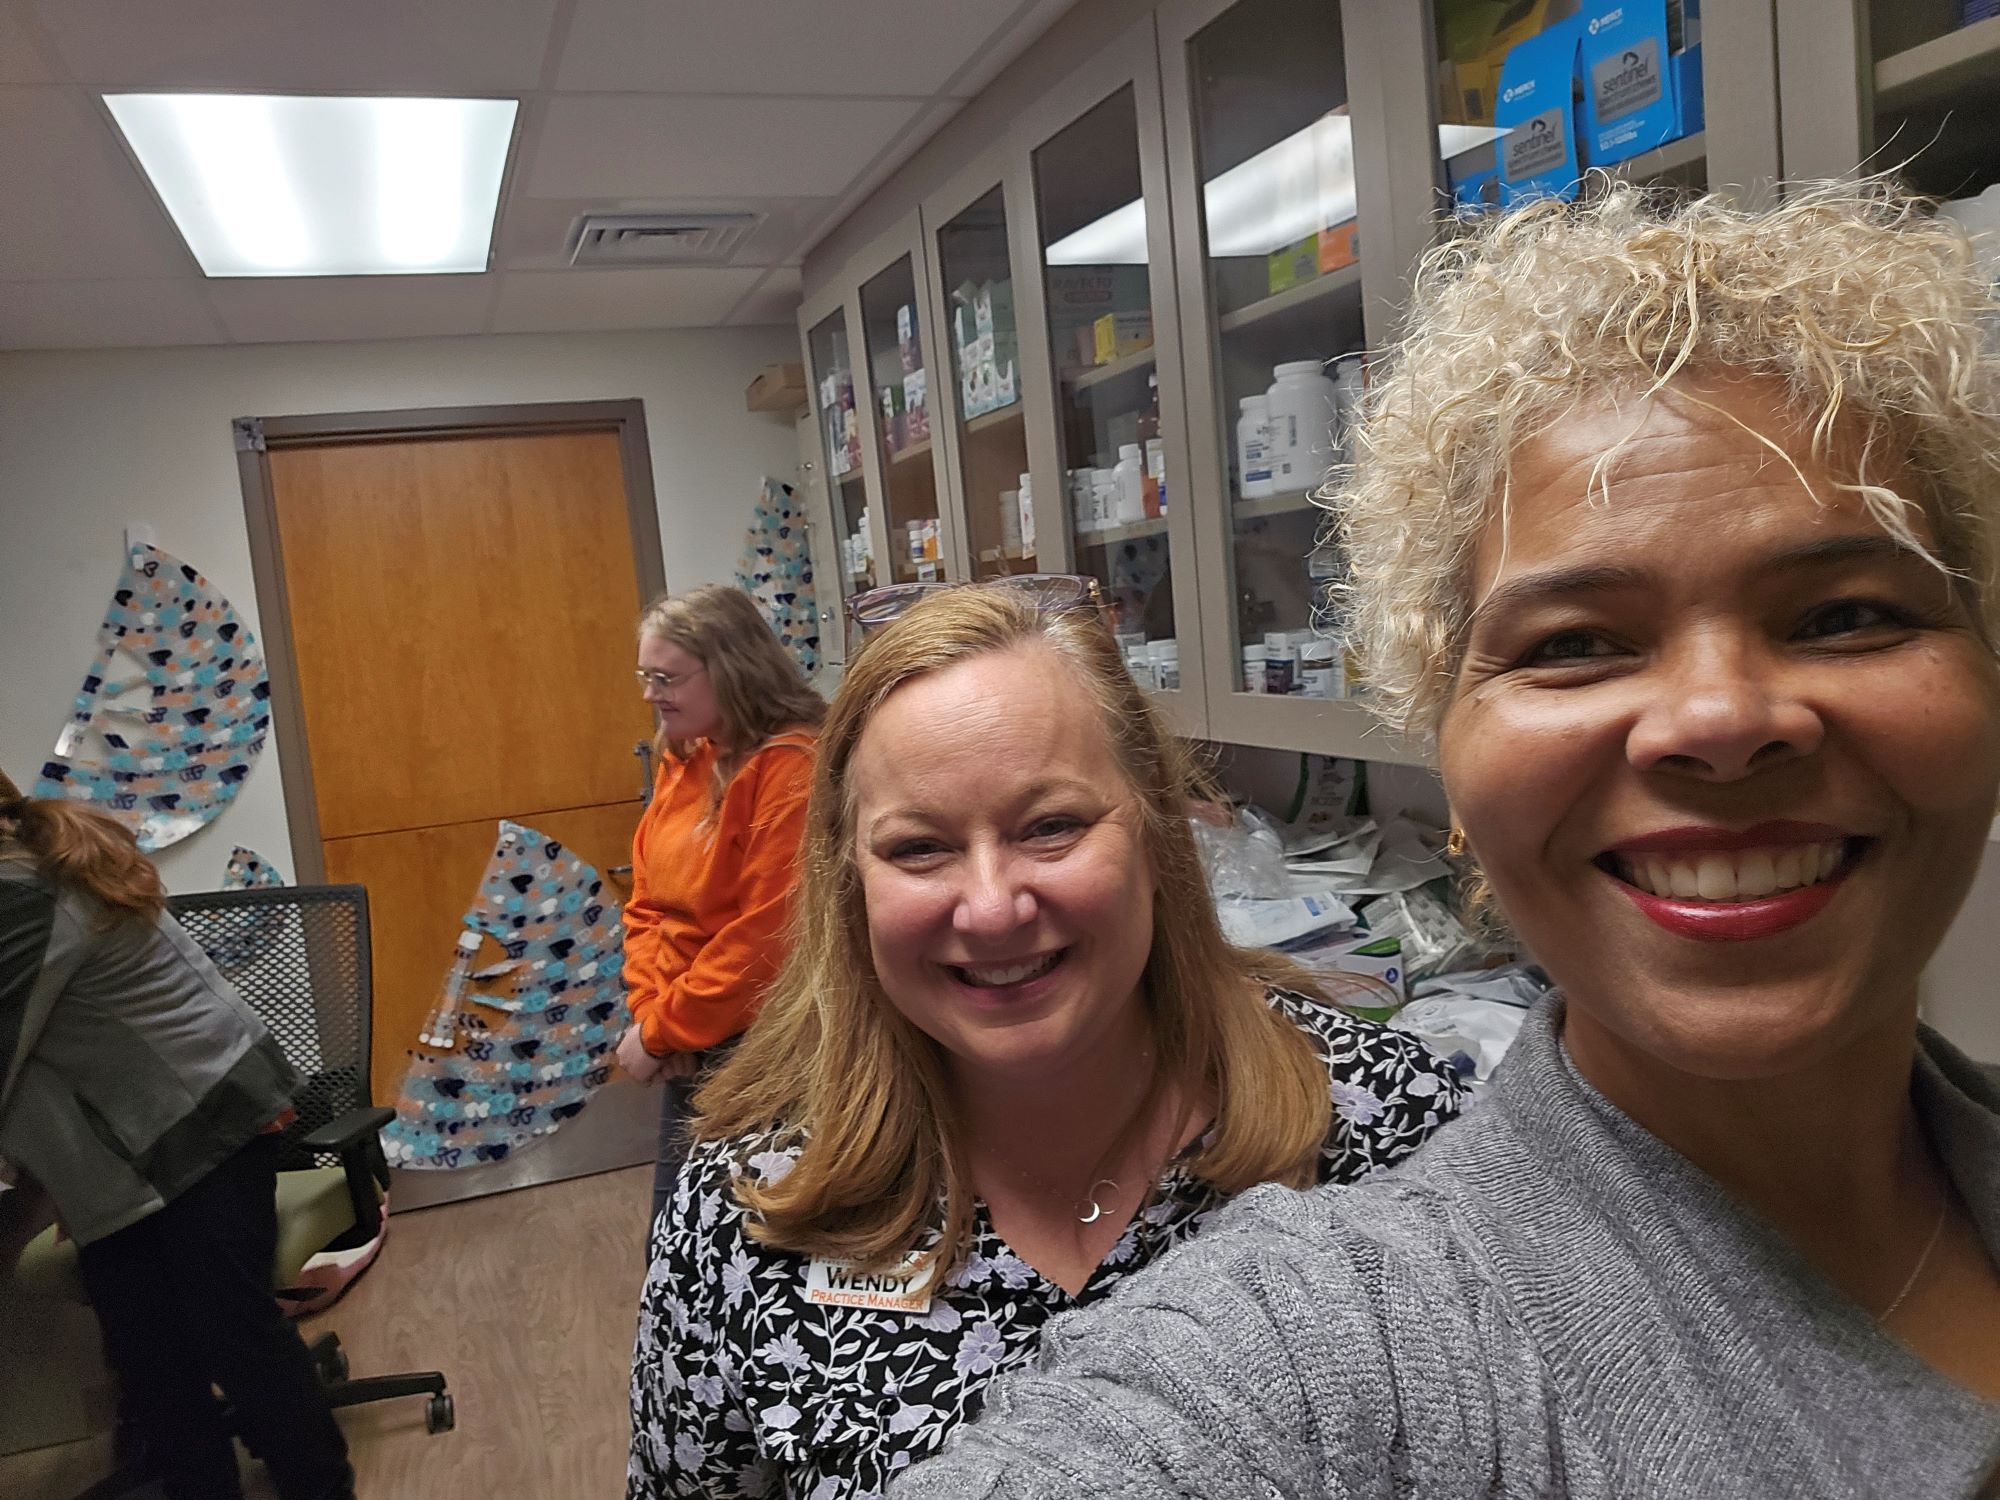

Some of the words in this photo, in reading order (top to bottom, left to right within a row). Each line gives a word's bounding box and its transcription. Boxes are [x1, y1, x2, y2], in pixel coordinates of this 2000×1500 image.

[826, 1266, 914, 1294] WENDY
[811, 1289, 865, 1306] PRACTICE
[867, 1294, 924, 1311] MANAGER
